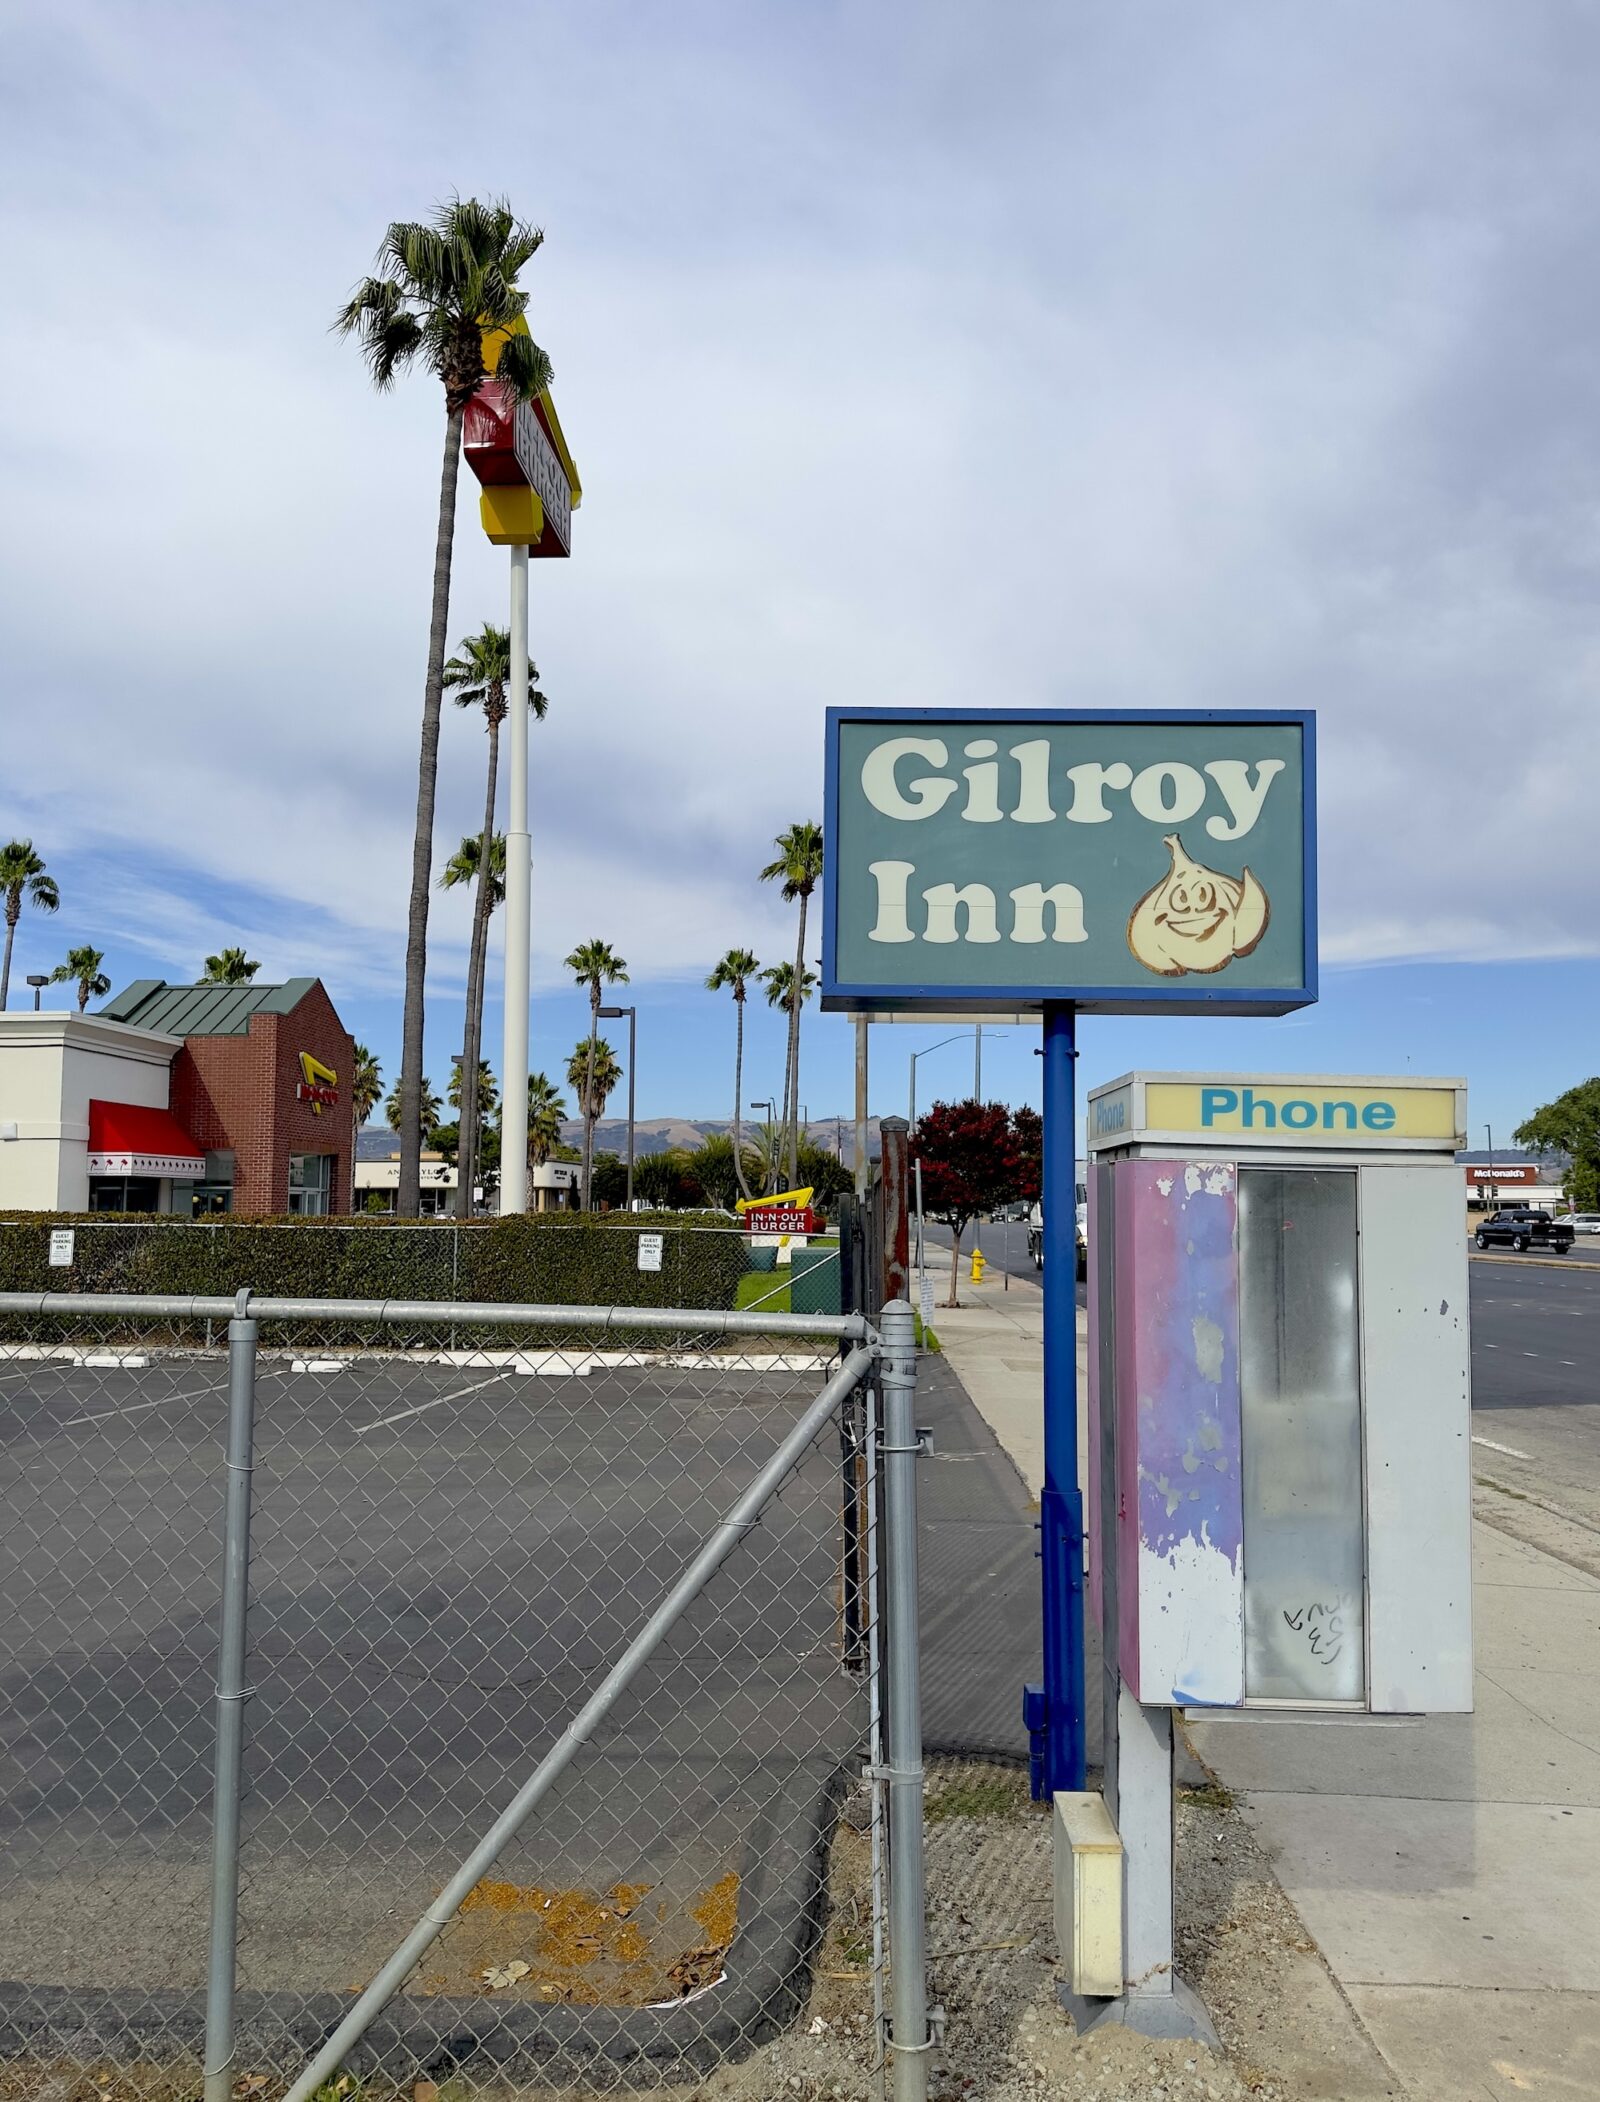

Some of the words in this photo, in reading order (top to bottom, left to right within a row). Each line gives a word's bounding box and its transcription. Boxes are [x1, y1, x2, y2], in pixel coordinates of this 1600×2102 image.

[518, 426, 568, 541] BURGER
[861, 737, 1286, 841] Gilroy
[867, 860, 1089, 943] Inn
[1097, 1100, 1125, 1135] Phone
[1201, 1089, 1396, 1130] Phone
[1474, 1169, 1525, 1178] McDonald's
[750, 1221, 805, 1231] BURGER
[751, 1212, 807, 1221] IN-N-OUT
